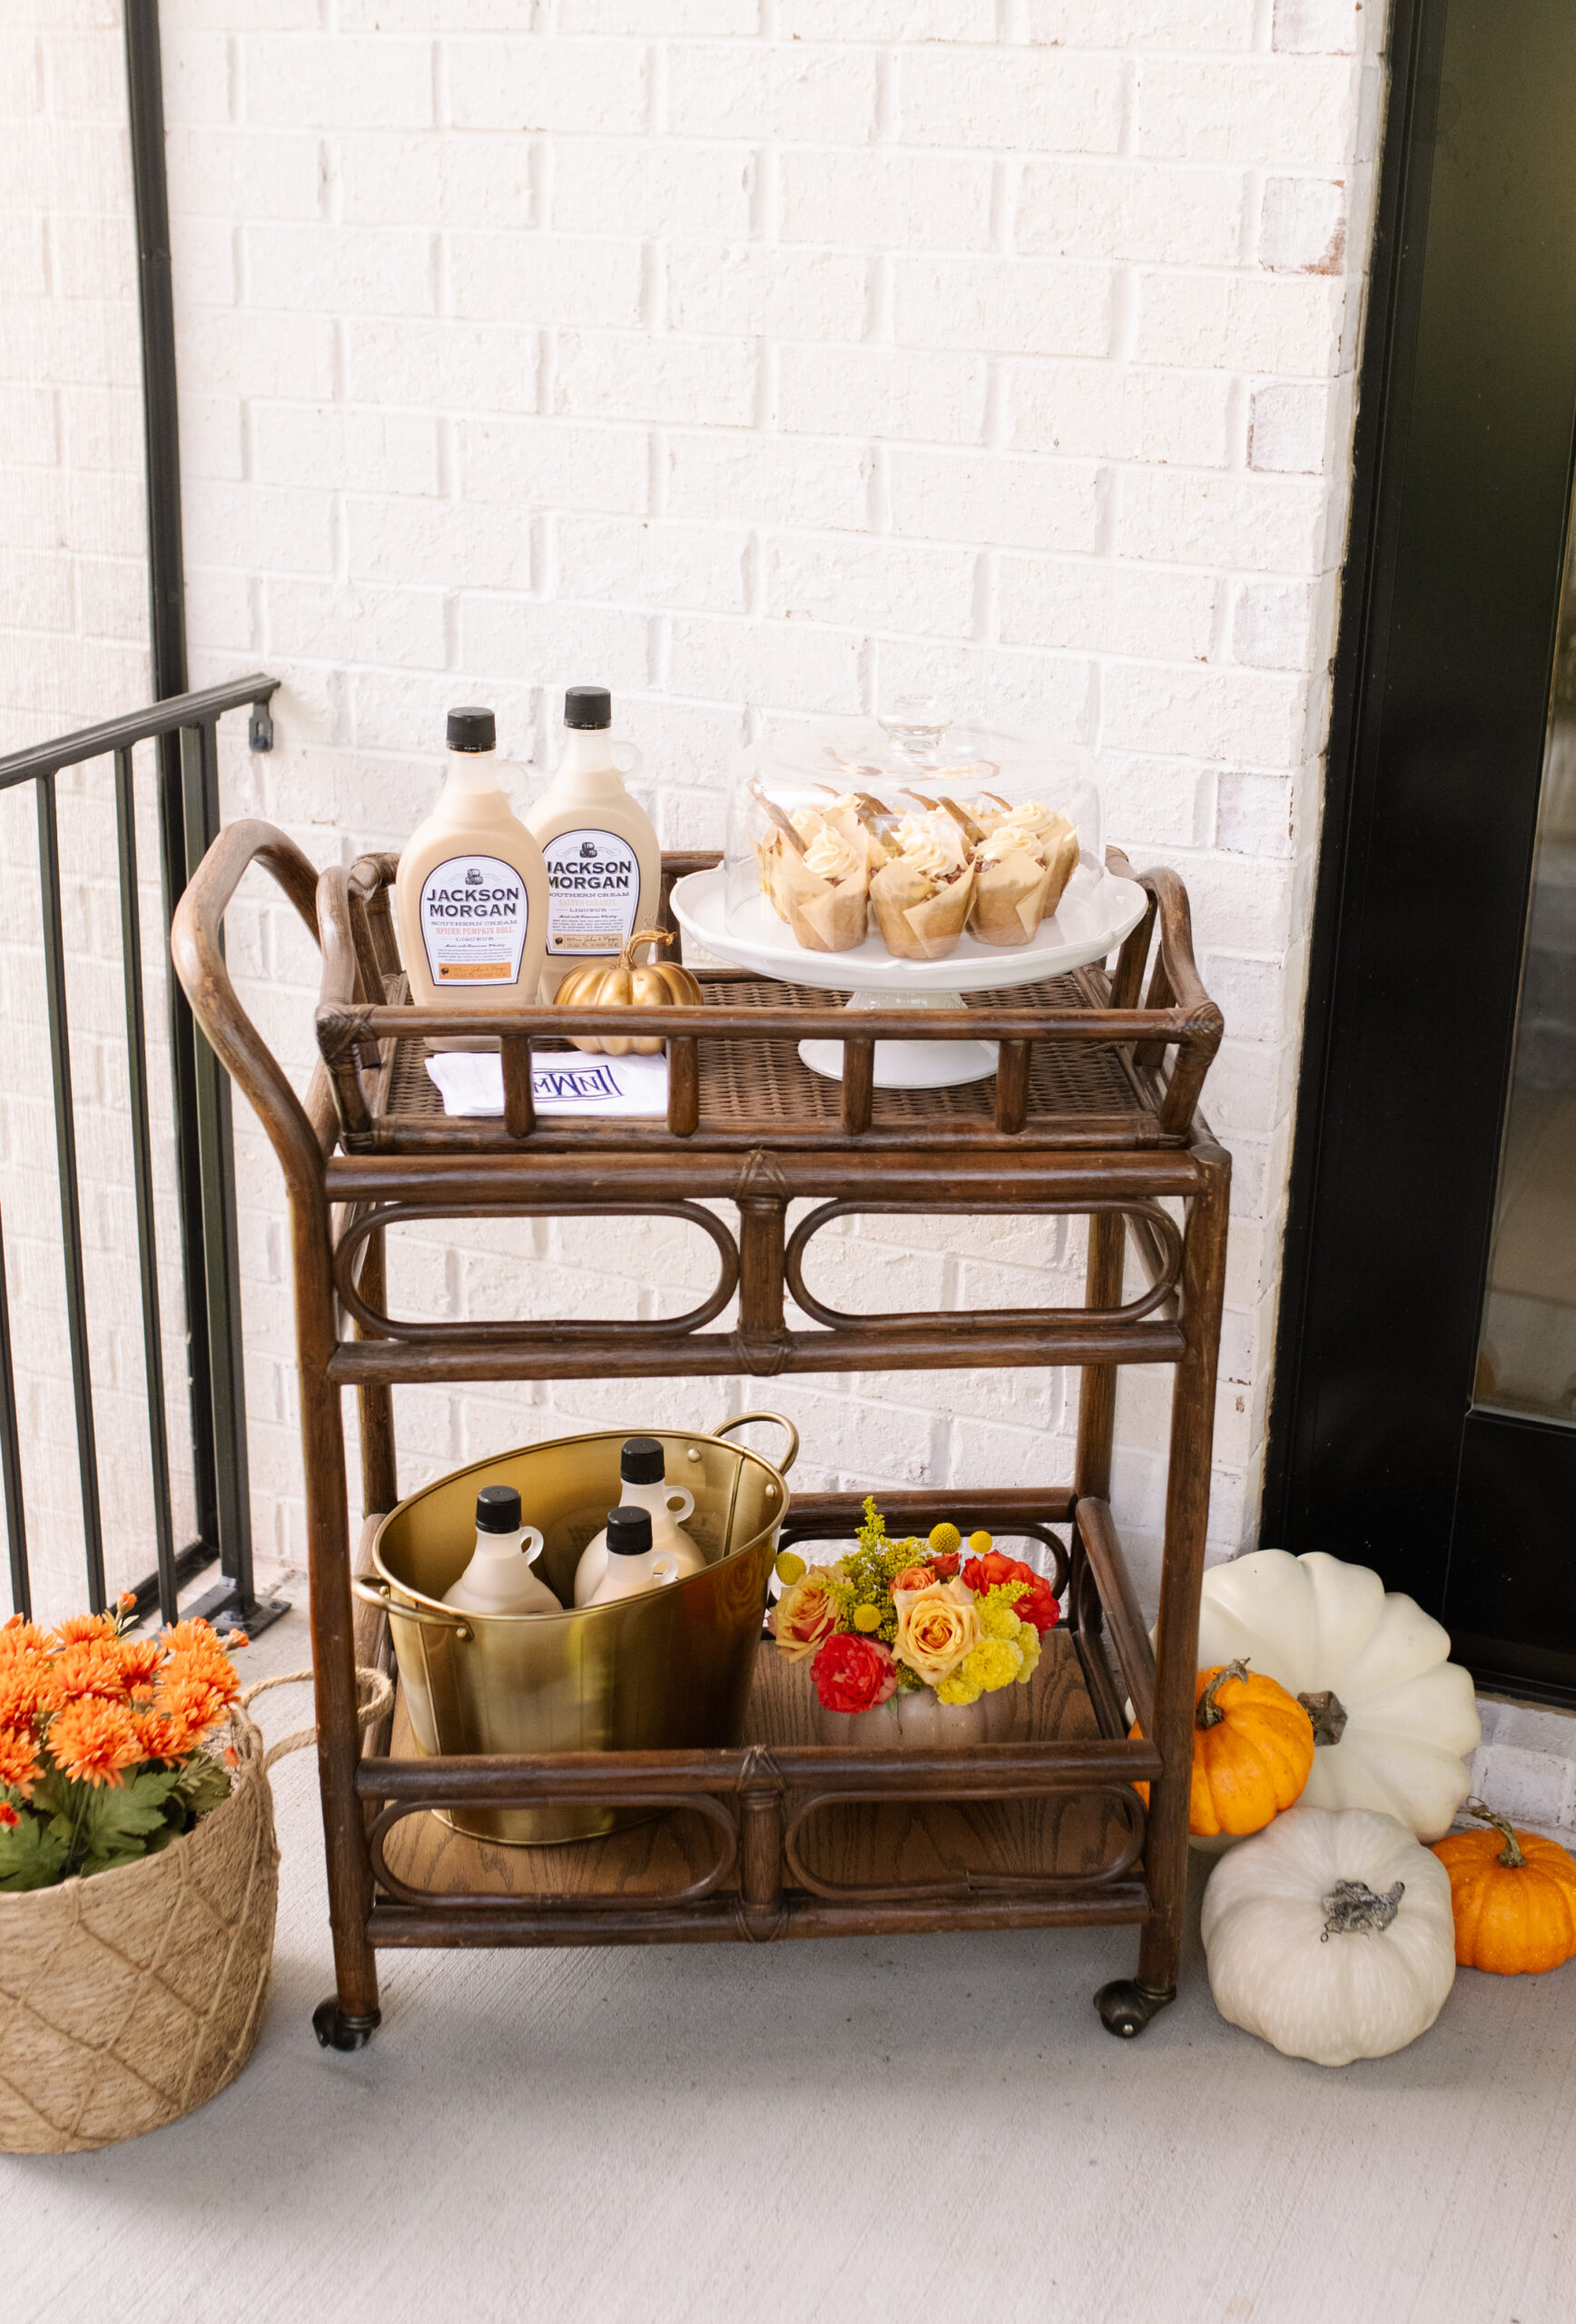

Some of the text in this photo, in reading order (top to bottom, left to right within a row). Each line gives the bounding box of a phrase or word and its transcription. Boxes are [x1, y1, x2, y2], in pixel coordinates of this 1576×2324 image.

[547, 861, 632, 874] JACKSON
[549, 876, 629, 889] MORGAN
[427, 888, 519, 902] JACKSON
[429, 903, 517, 918] MORGAN
[436, 926, 514, 935] SPICED PUMPKIN ROLL
